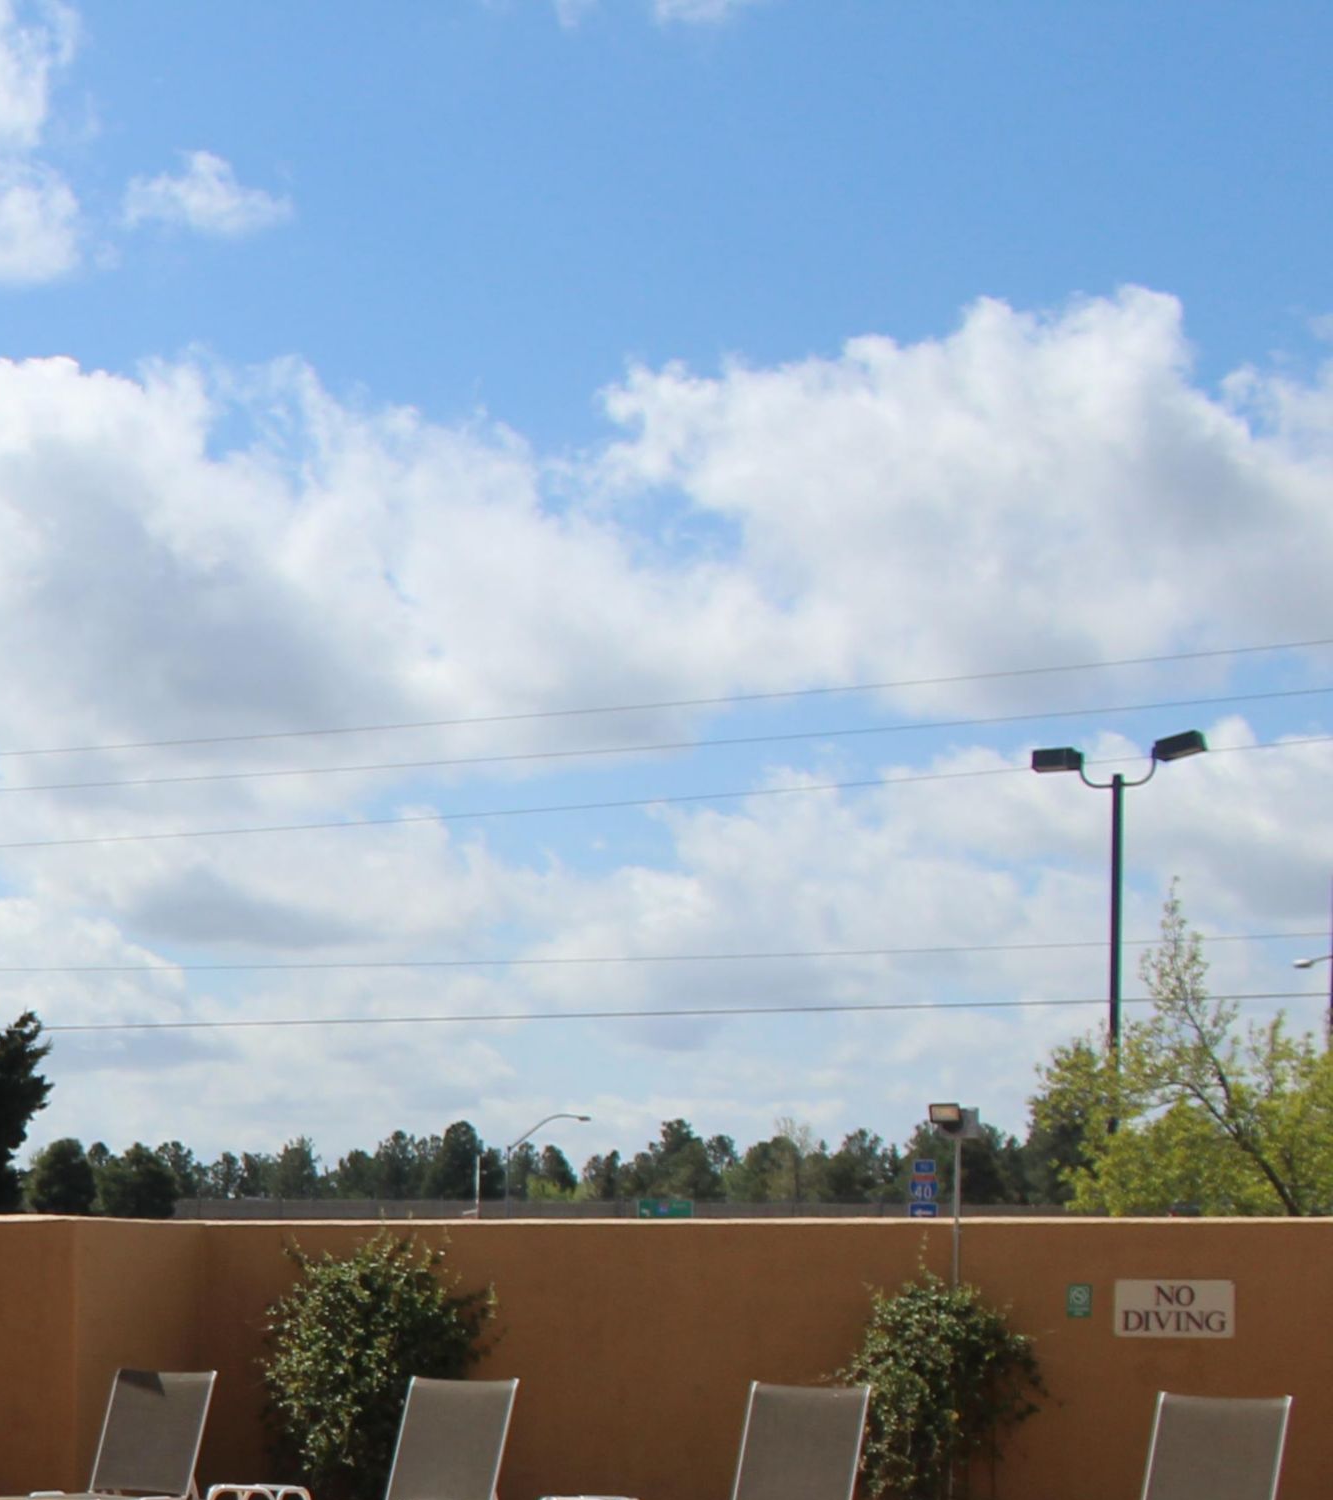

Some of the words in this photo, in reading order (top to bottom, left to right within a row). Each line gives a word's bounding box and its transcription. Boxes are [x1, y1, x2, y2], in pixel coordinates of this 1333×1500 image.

[915, 1183, 932, 1199] 40
[1154, 1285, 1195, 1307] NO
[1122, 1310, 1226, 1332] DIVING
